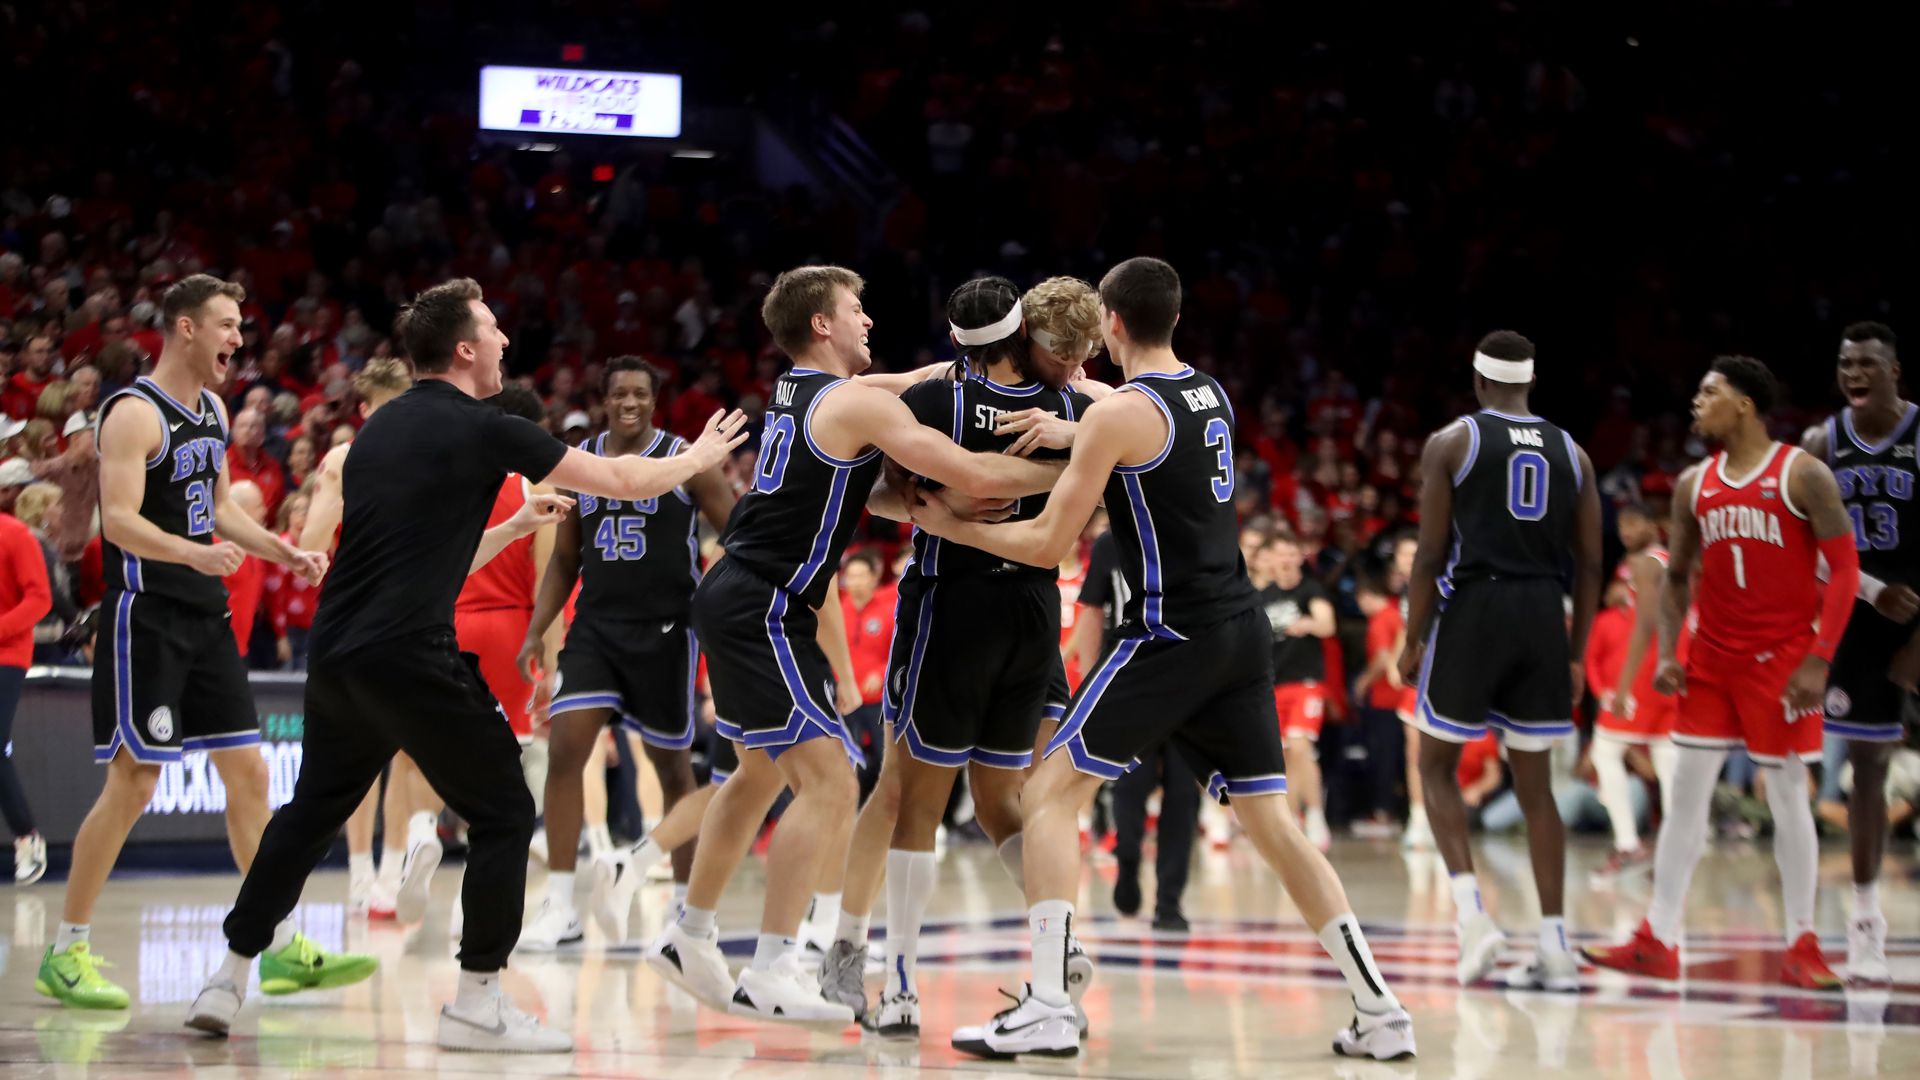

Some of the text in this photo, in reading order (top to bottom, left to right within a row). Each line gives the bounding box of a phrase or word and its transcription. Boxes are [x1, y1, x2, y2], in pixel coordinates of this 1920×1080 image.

[534, 73, 642, 96] WILDCATS
[1179, 384, 1220, 413] DEMIN
[169, 436, 226, 482] BYU
[1204, 417, 1235, 503] 3
[1507, 427, 1545, 448] MAG
[1506, 449, 1550, 521] 0
[1834, 464, 1916, 500] BYU
[185, 477, 216, 537] 21
[1698, 503, 1785, 549] ARIZONA
[1848, 502, 1900, 551] 13
[594, 515, 648, 562] 45
[1729, 542, 1747, 589] 1
